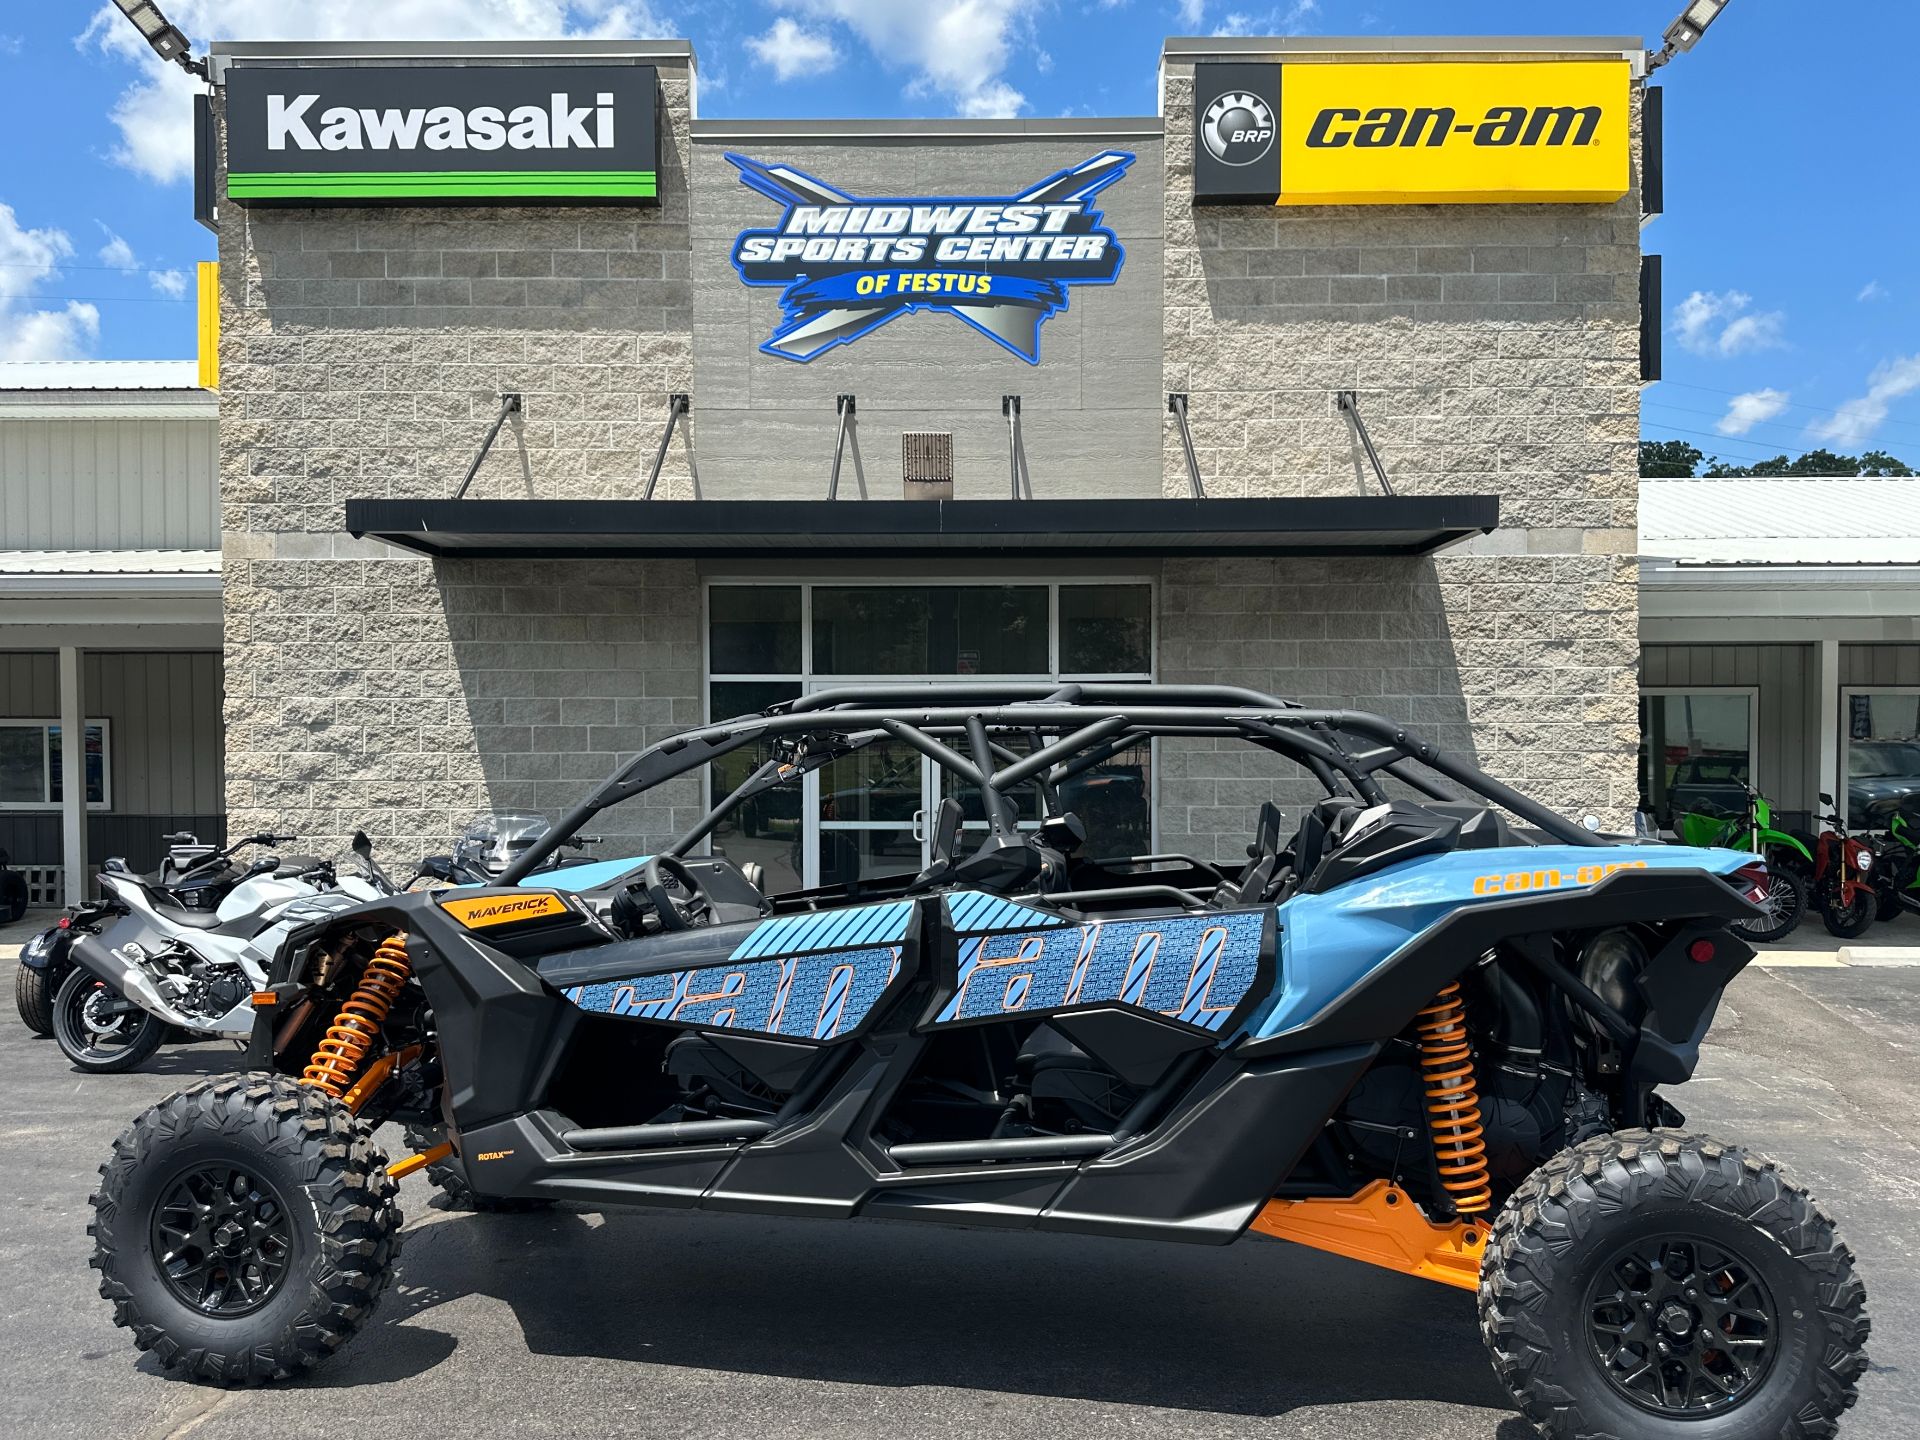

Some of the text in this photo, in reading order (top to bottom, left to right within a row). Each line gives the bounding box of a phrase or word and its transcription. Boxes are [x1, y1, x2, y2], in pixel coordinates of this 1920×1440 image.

[267, 92, 614, 151] Kawasaki
[1305, 105, 1602, 147] can-am
[1231, 130, 1271, 143] BRP
[785, 203, 1083, 235] MIDWEST
[739, 234, 1109, 262] SPORTS CENTER
[856, 273, 992, 295] OF FESTUS
[467, 896, 550, 920] MAVERICK
[478, 1151, 505, 1161] ROTAX
